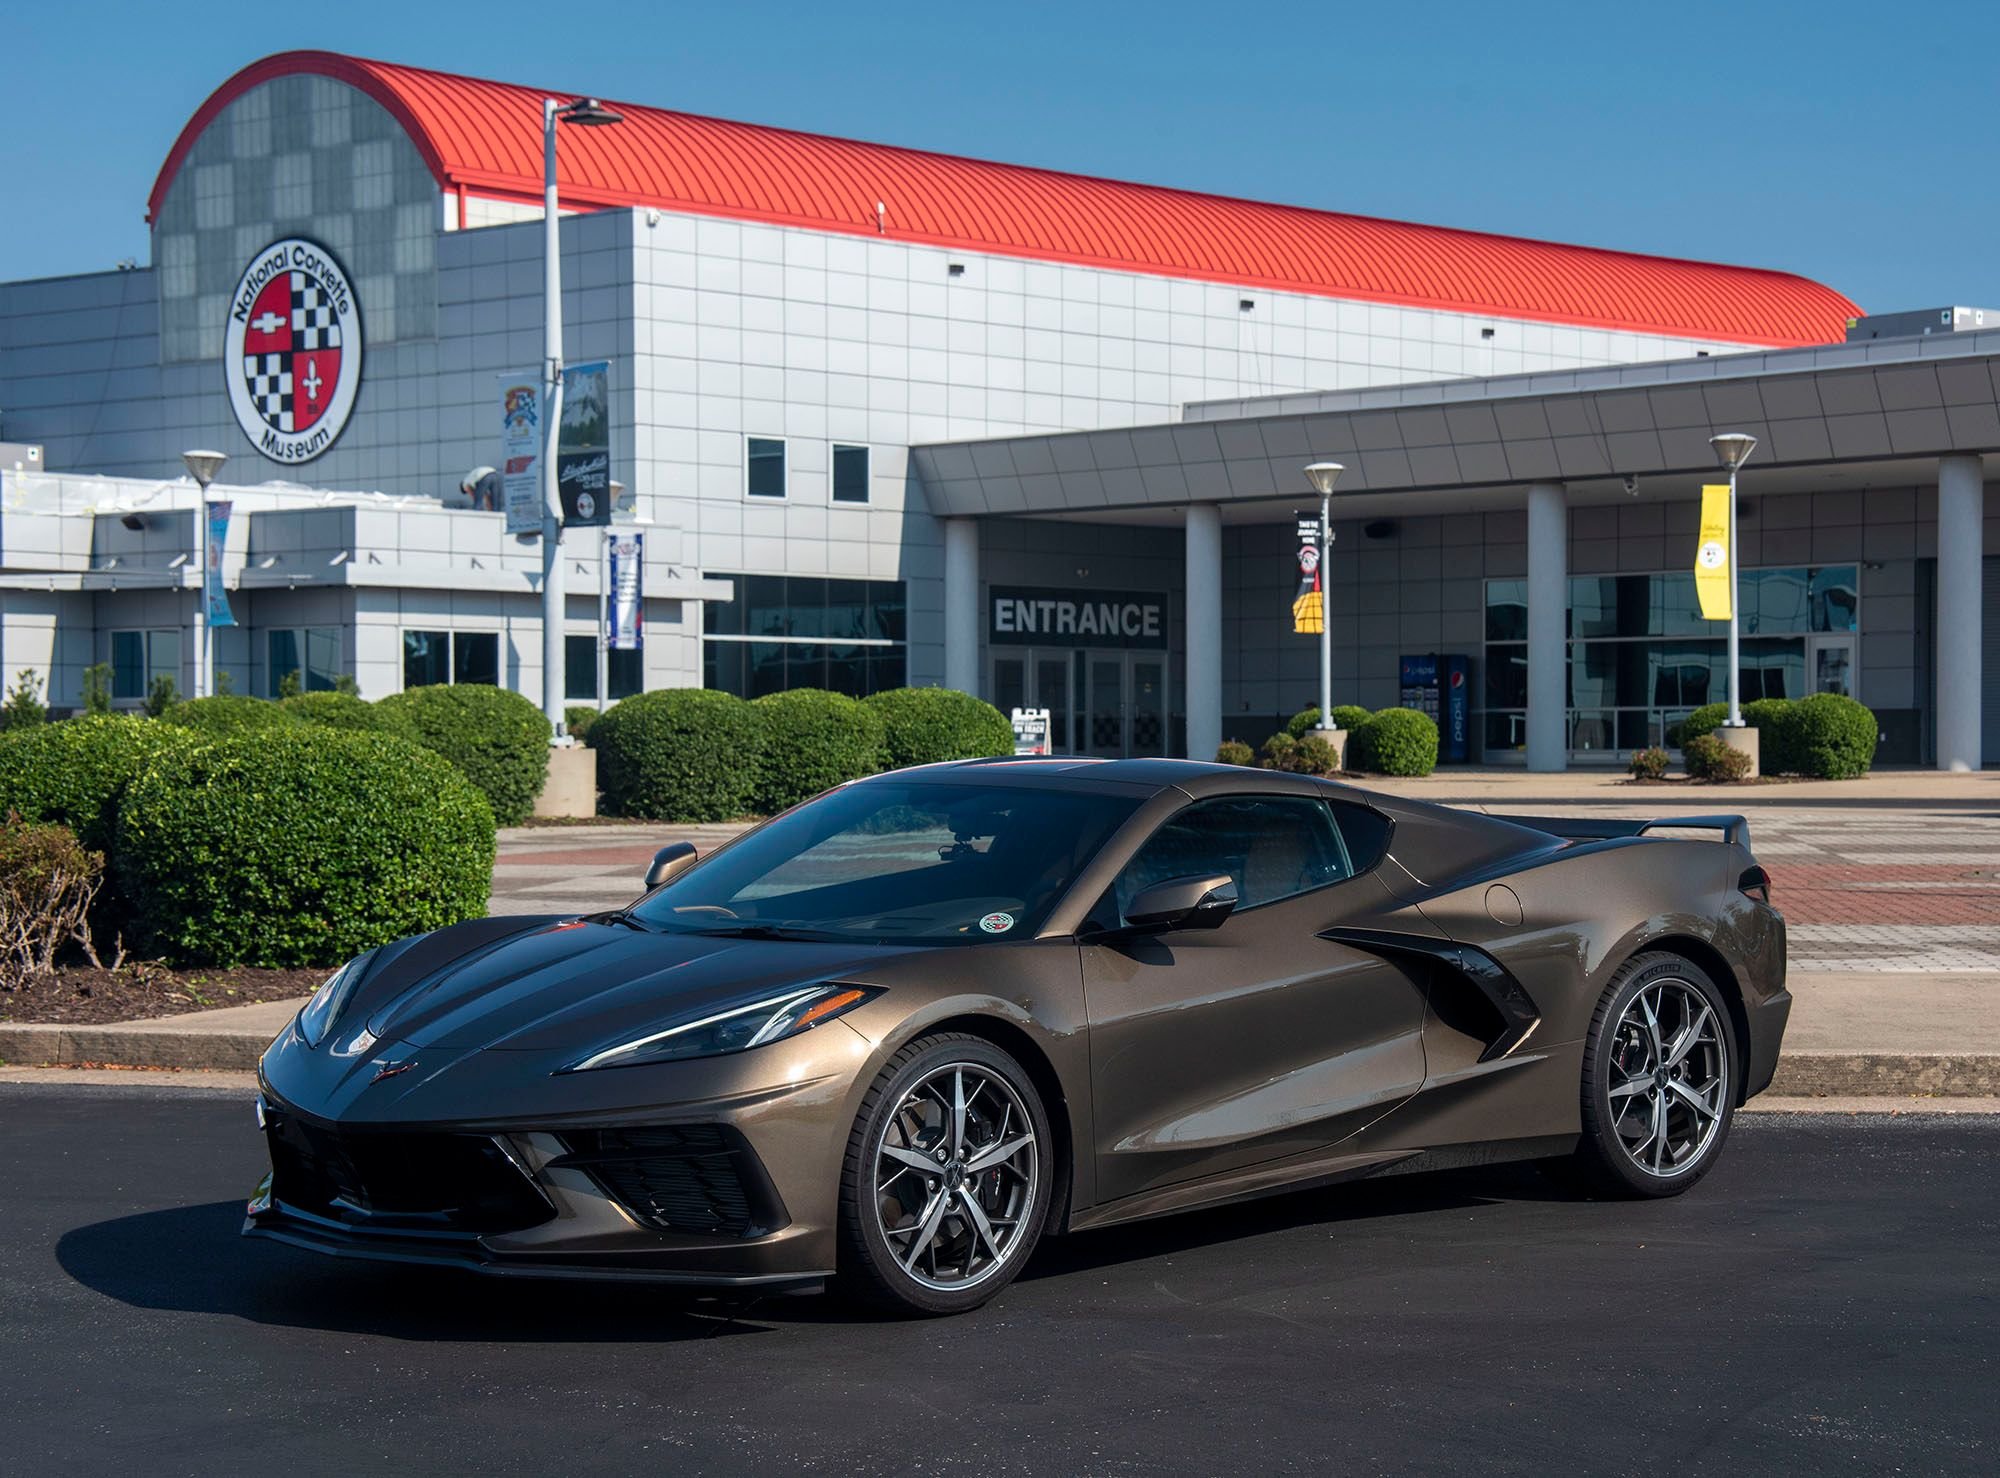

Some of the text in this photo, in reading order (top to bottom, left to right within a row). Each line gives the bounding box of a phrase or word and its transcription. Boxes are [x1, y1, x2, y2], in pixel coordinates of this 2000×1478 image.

[233, 246, 349, 323] National Corvette
[261, 428, 330, 459] Museum
[995, 598, 1161, 637] ENTRANCE
[1452, 698, 1464, 742] pepsi
